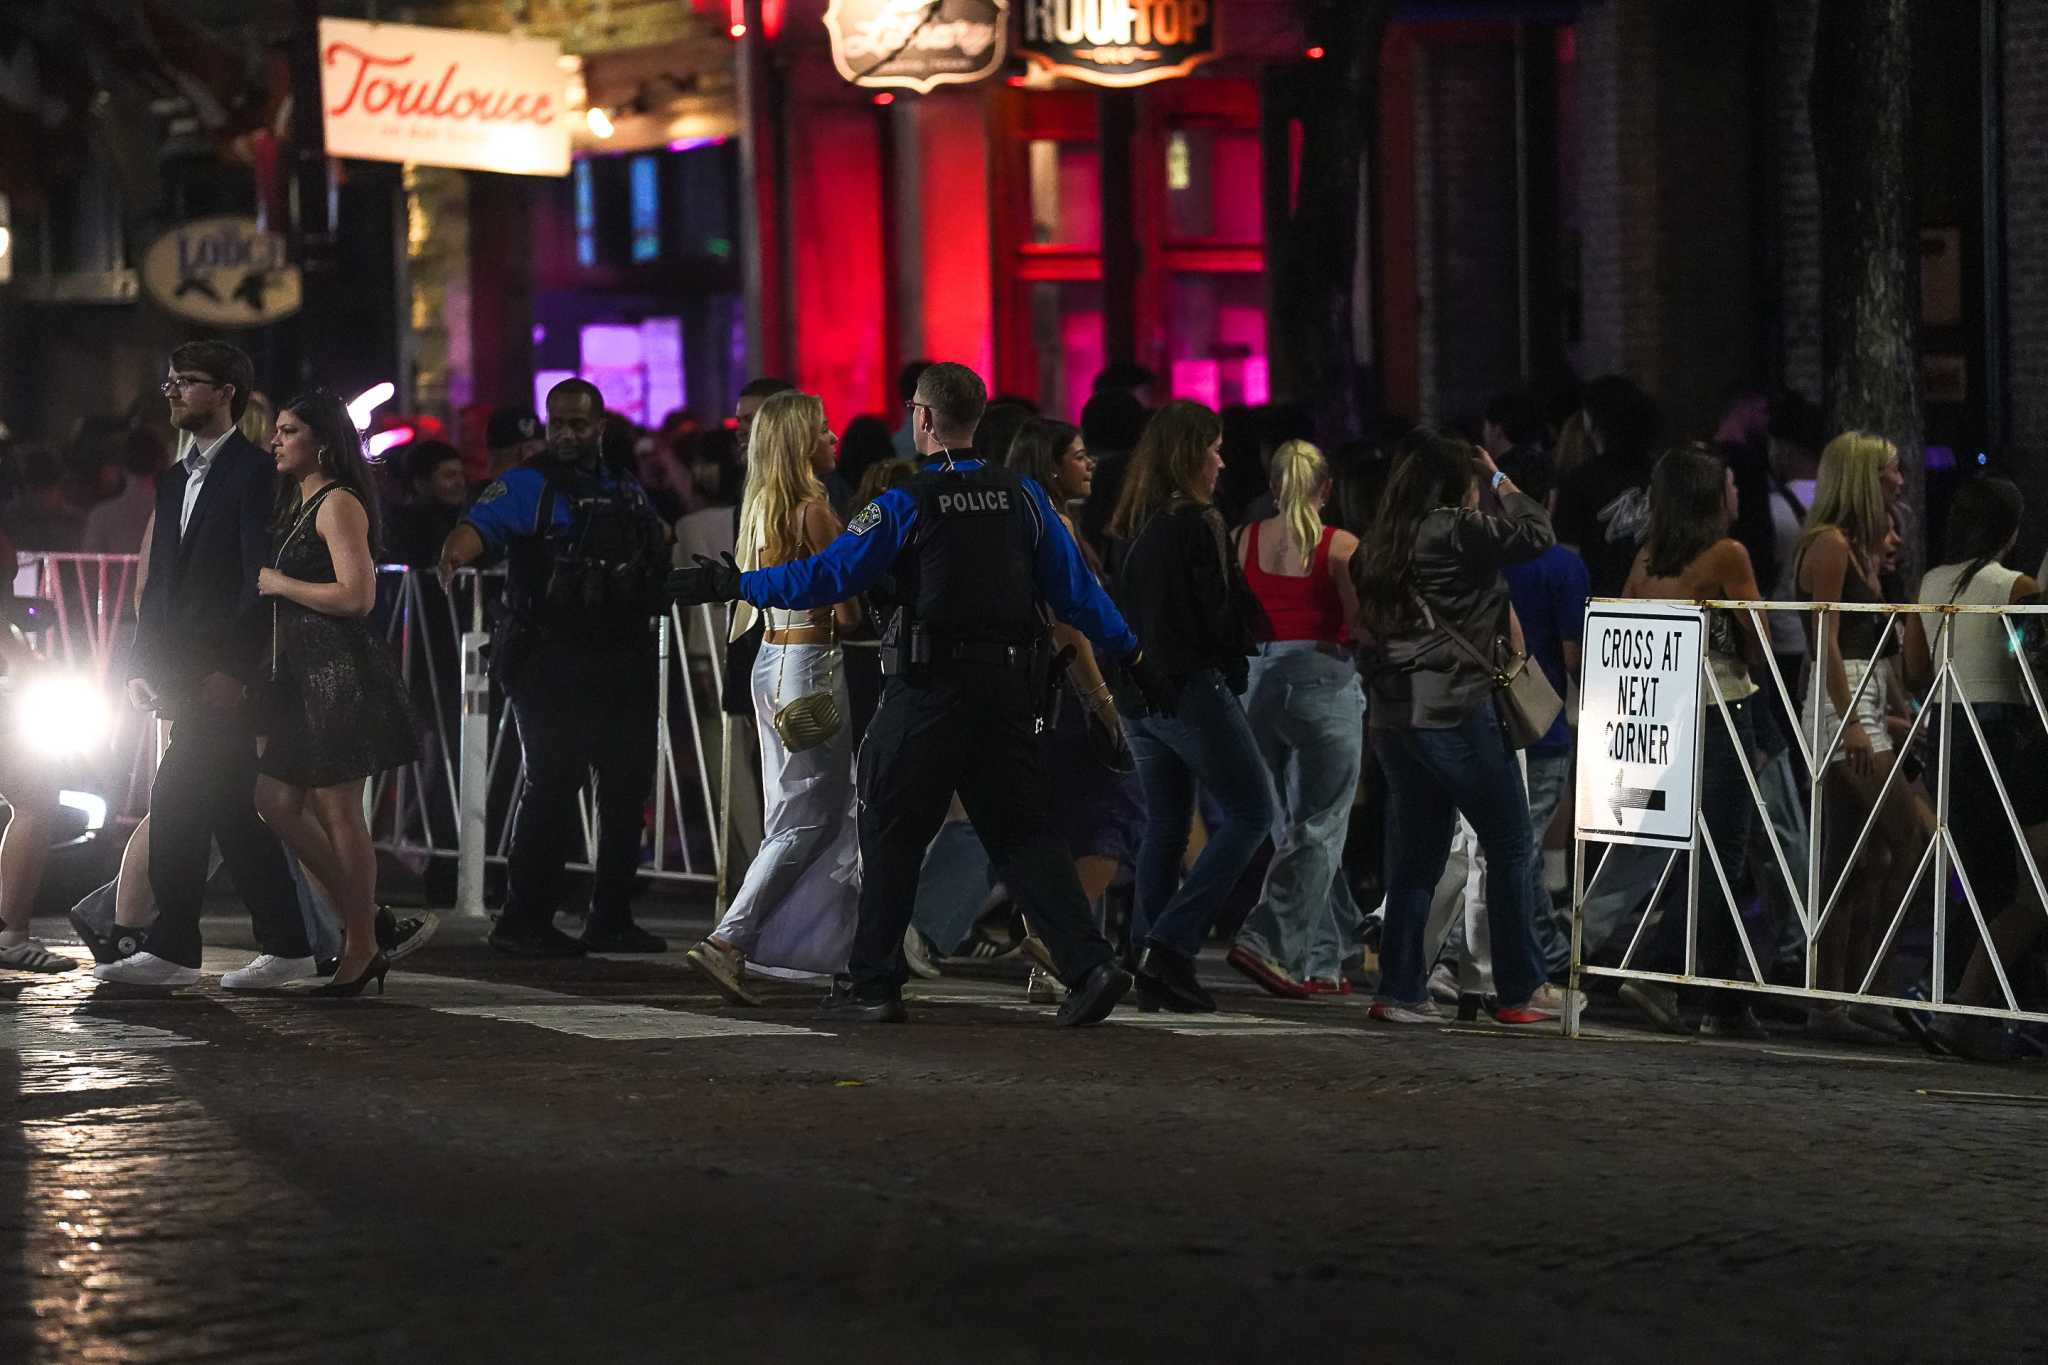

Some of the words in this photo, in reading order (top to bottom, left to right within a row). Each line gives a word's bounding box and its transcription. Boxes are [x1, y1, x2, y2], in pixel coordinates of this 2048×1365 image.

[323, 41, 556, 125] Toulouse
[938, 490, 1010, 513] POLICE
[1601, 627, 1654, 670] CROSS
[1661, 631, 1682, 672] AT
[1617, 675, 1660, 718] NEXT
